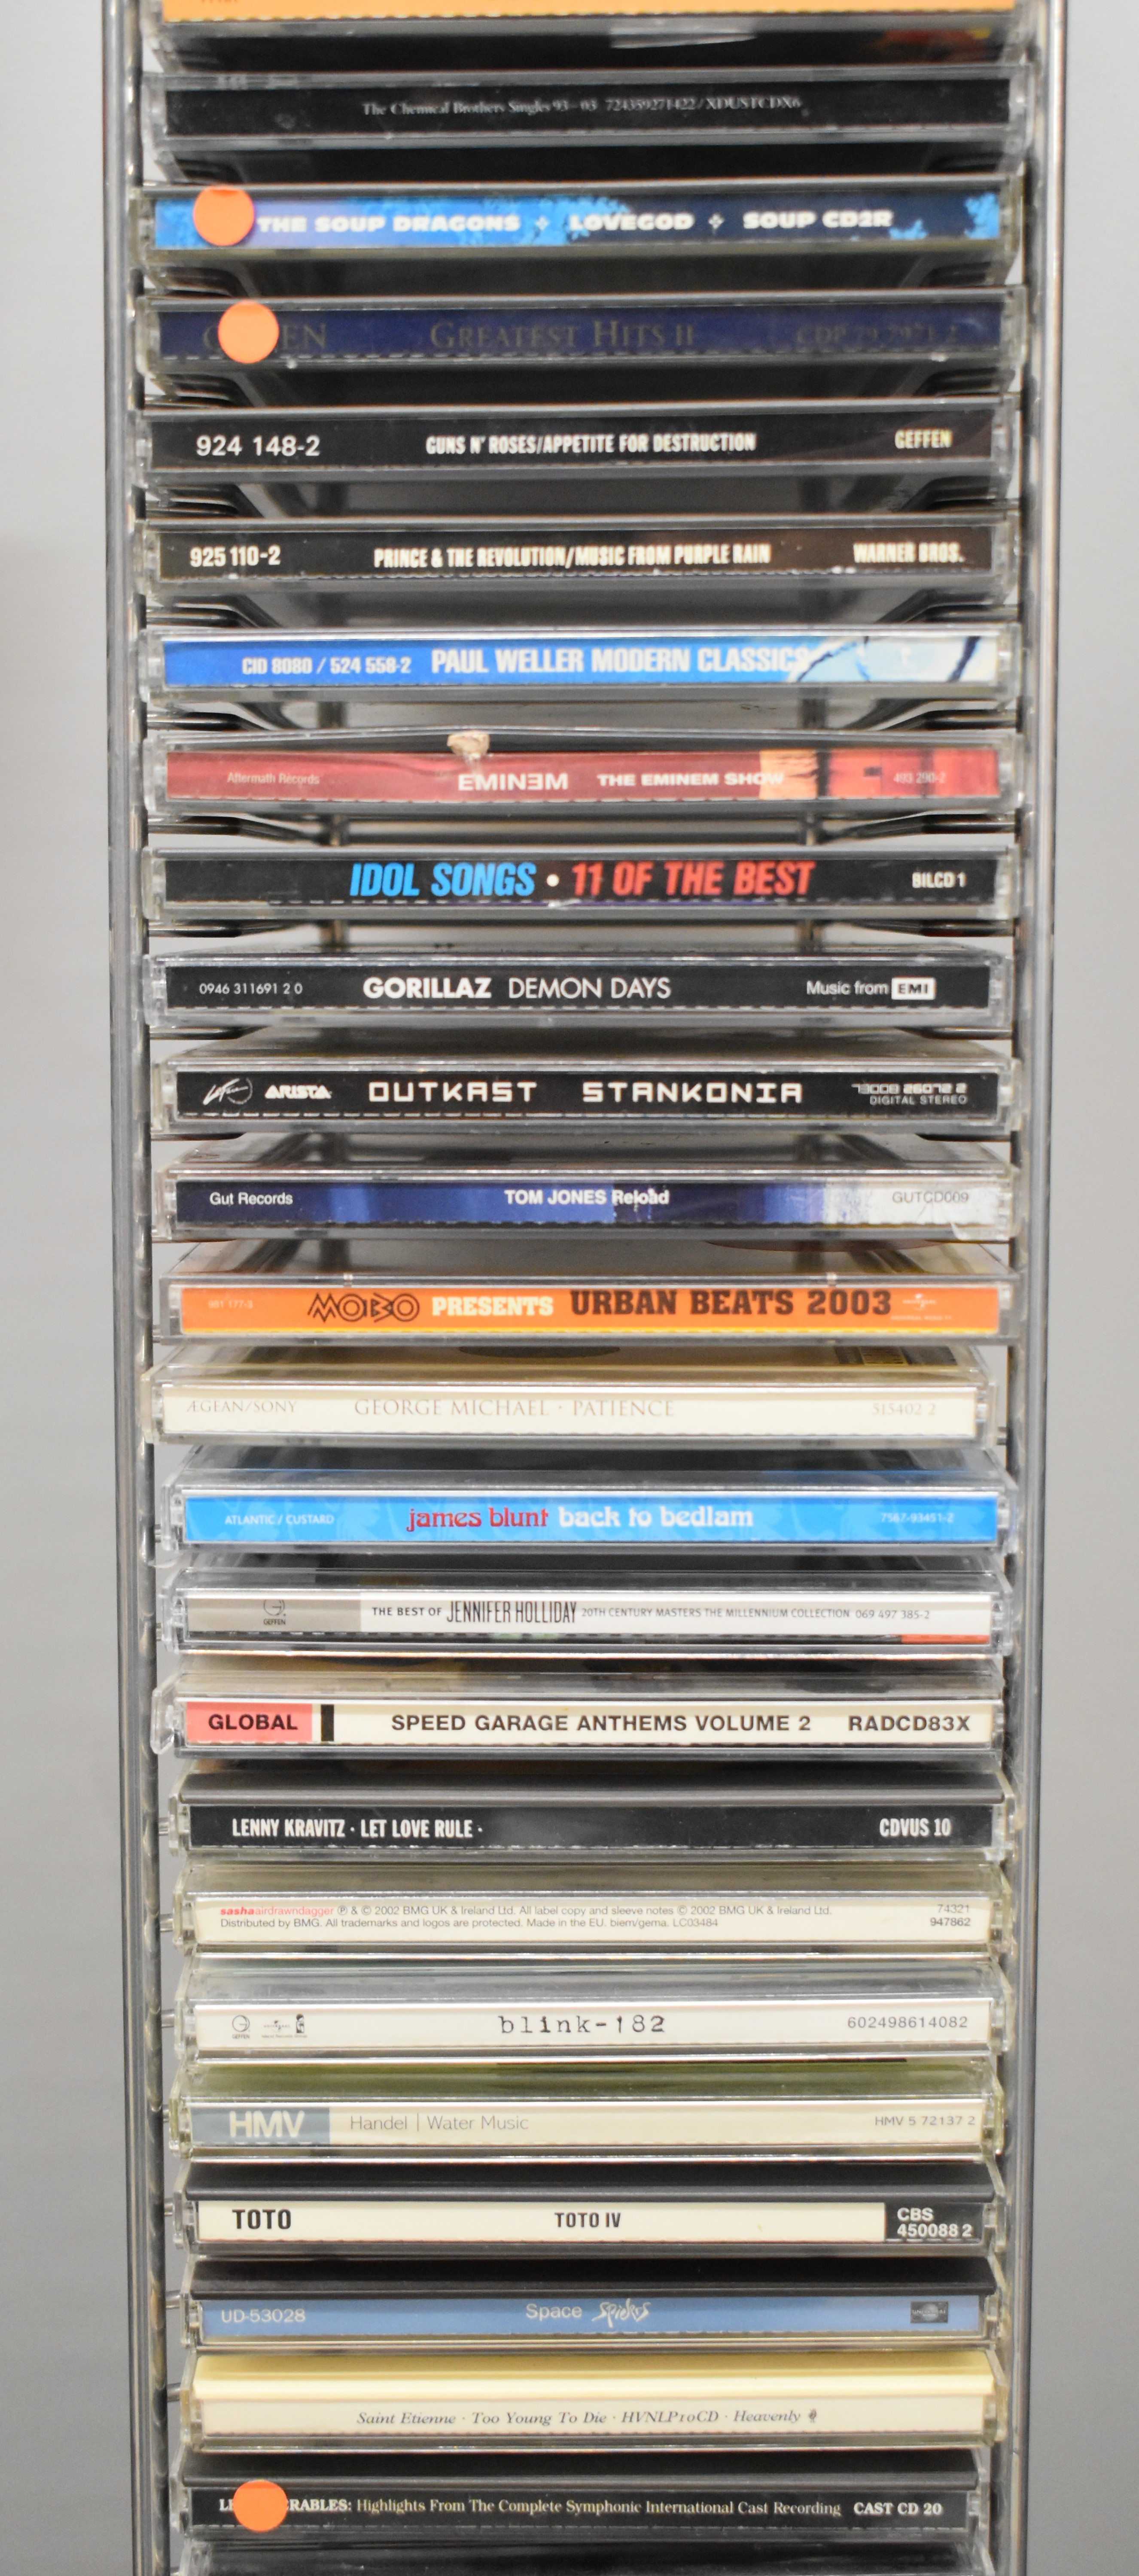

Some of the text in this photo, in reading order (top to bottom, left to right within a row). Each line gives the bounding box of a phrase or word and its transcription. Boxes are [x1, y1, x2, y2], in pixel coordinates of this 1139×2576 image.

[453, 101, 505, 114] Brothers
[508, 100, 551, 115] Singles
[393, 210, 893, 232] DRAGONS LOVEGOD SOUP CD2R
[196, 435, 320, 457] 924 148-2
[426, 432, 756, 455] GUNS ROSES/APPETITE DESTRUCTION
[895, 429, 952, 449] GEFFEN
[190, 545, 281, 567] 925 110-2
[374, 544, 771, 568] PRINCE REVOLUTION/MUSIC PURPLE RAIN
[853, 542, 964, 563] WARNER BROS.
[242, 656, 411, 675] CID 8080 558-2
[432, 646, 809, 674] PAUL WELLER MODERN CLASSICS
[227, 772, 320, 785] Aftermath Records
[641, 773, 719, 786] EMINEM
[725, 773, 784, 785] SHOW
[350, 861, 815, 896] IDOL SONGS 11 BEST
[912, 872, 956, 888] BILCD
[199, 982, 277, 994] 0946 311691
[363, 977, 671, 999] GORILLAZ DEMON DAYS
[807, 980, 928, 995] Music from EMI
[265, 1085, 332, 1099] ARISTA
[368, 1081, 802, 1103] OUTKAST STANKONIA
[869, 1095, 968, 1105] DIGITAL STEREO
[209, 1192, 293, 1205] Gut Records
[504, 1189, 670, 1205] TOM JONES Reload
[892, 1191, 970, 1204] GUTCD009
[432, 1296, 554, 1316] PRESENTS
[570, 1289, 677, 1315] URBAN
[690, 1289, 794, 1315] BEATS
[808, 1288, 891, 1315] 2003
[355, 1399, 674, 1417] GEORGE MICHAEL PATIENCE
[872, 1402, 922, 1416] 515402
[225, 1513, 335, 1526] ATLANTIC CUSTARD
[406, 1505, 754, 1532] james blunt back bedlam
[397, 1601, 850, 1623] BEST JENNIFER HOLLIDAY 20TH COLLECTION
[208, 1714, 298, 1730] GLOBAL
[392, 1714, 789, 1731] SPEED GARAGE ANTHEMS VOLUME
[849, 1715, 969, 1731] RADCD83X
[232, 1818, 473, 1838] LENNY KRAVITZ LET LOVE RULE
[879, 1818, 930, 1837] CDVUS
[375, 1905, 399, 1915] 2002
[403, 1905, 429, 1915] BMG
[432, 1905, 448, 1915] UK
[461, 1905, 495, 1915] Ireland
[498, 1905, 516, 1915] Ltd.
[519, 1905, 531, 1914] All
[535, 1905, 558, 1915] label
[561, 1907, 587, 1917] copy
[589, 1905, 608, 1915] and
[611, 1905, 643, 1915] sleeve
[646, 1906, 674, 1915] notes
[691, 1905, 716, 1915] 2002
[719, 1905, 745, 1915] BMG
[748, 1905, 764, 1915] UK
[777, 1905, 811, 1915] Ireland
[814, 1905, 829, 1915] Ltd.
[937, 1903, 970, 1914] 74321
[220, 1918, 718, 1929] Distributed trademarks protected. biem/gema. LC03484
[930, 1917, 971, 1926] 947862
[499, 2014, 665, 2033] blink-182
[847, 2016, 968, 2029] 602498614082
[229, 2108, 304, 2139] HMV
[350, 2115, 528, 2130] Handel Water Music
[875, 2115, 963, 2126] HMV 72137
[232, 2209, 291, 2230] TOTO
[554, 2212, 599, 2228] TOTO
[897, 2207, 934, 2222] CBS
[897, 2224, 959, 2238] 450088
[221, 2309, 305, 2324] UD-53028
[525, 2303, 582, 2323] Space
[357, 2413, 395, 2424] Saint
[400, 2412, 456, 2424] Etienne
[472, 2412, 500, 2424] Too
[507, 2412, 551, 2426] Young
[583, 2412, 606, 2424] Die
[733, 2410, 801, 2424] Heavenly
[357, 2499, 841, 2517] Highlights Complete Symphonic International Recording
[853, 2502, 894, 2515] CAST
